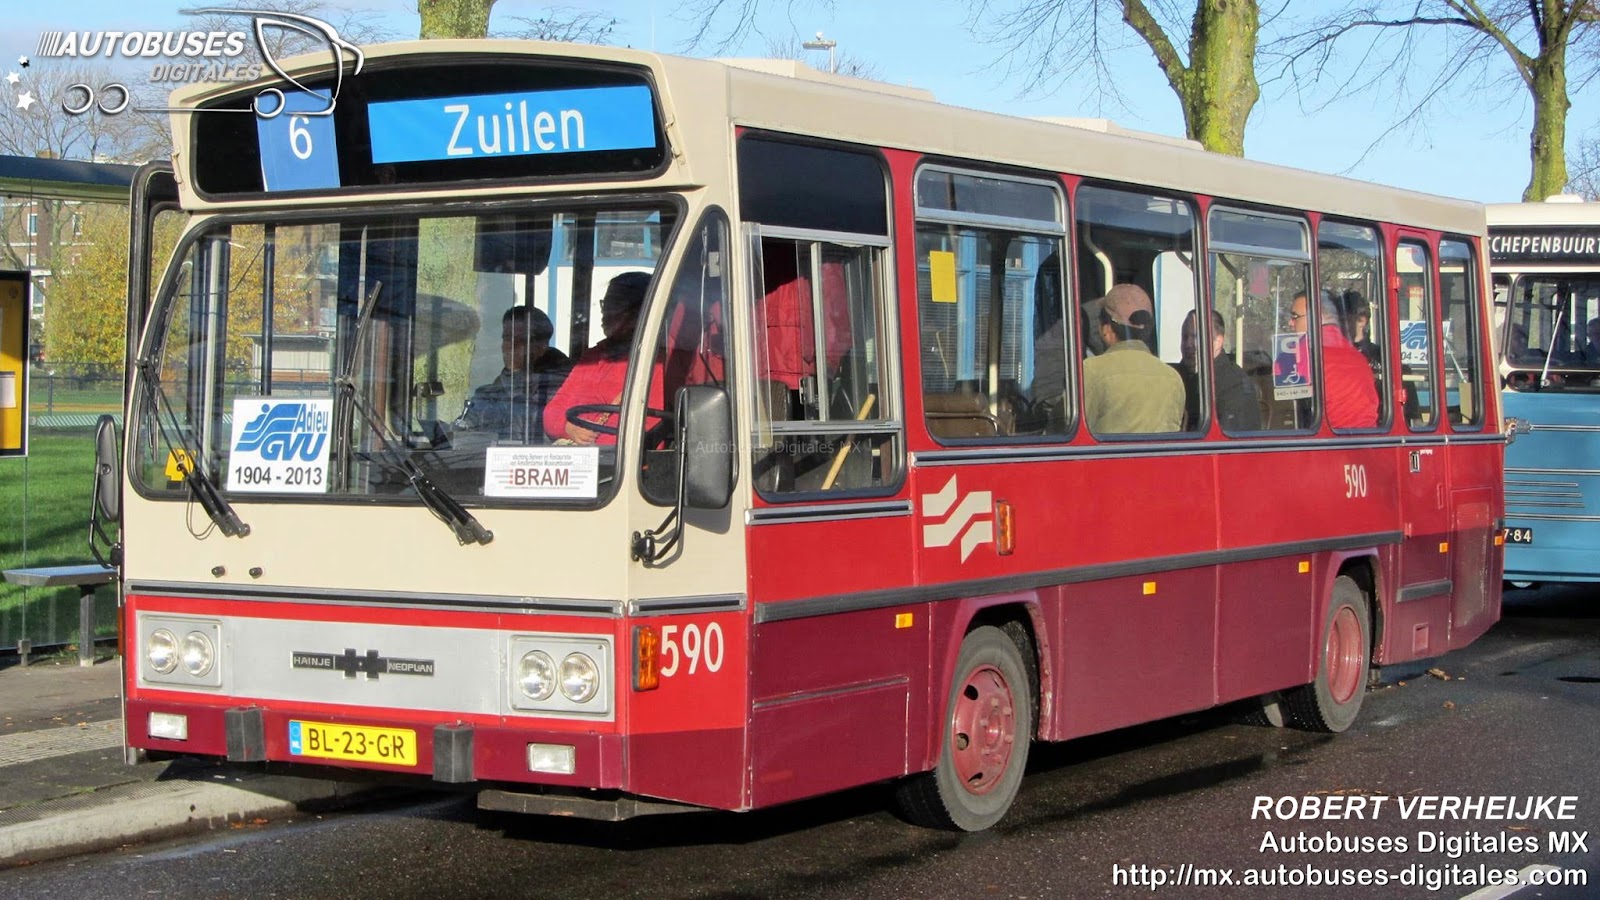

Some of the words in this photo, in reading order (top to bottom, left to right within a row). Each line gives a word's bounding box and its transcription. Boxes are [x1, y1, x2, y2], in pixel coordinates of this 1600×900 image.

[289, 113, 313, 160] 6
[444, 100, 585, 156] Zuilen
[294, 403, 329, 433] Adieu
[260, 433, 328, 462] GVU
[235, 466, 272, 485] 1904
[285, 466, 323, 486] 2013
[514, 468, 569, 486] BRAM
[1343, 463, 1367, 498] 590
[293, 656, 331, 667] HAINJE
[388, 662, 433, 673] NEOPLAN
[660, 621, 724, 678] 590
[308, 728, 405, 759] BL-23-GR
